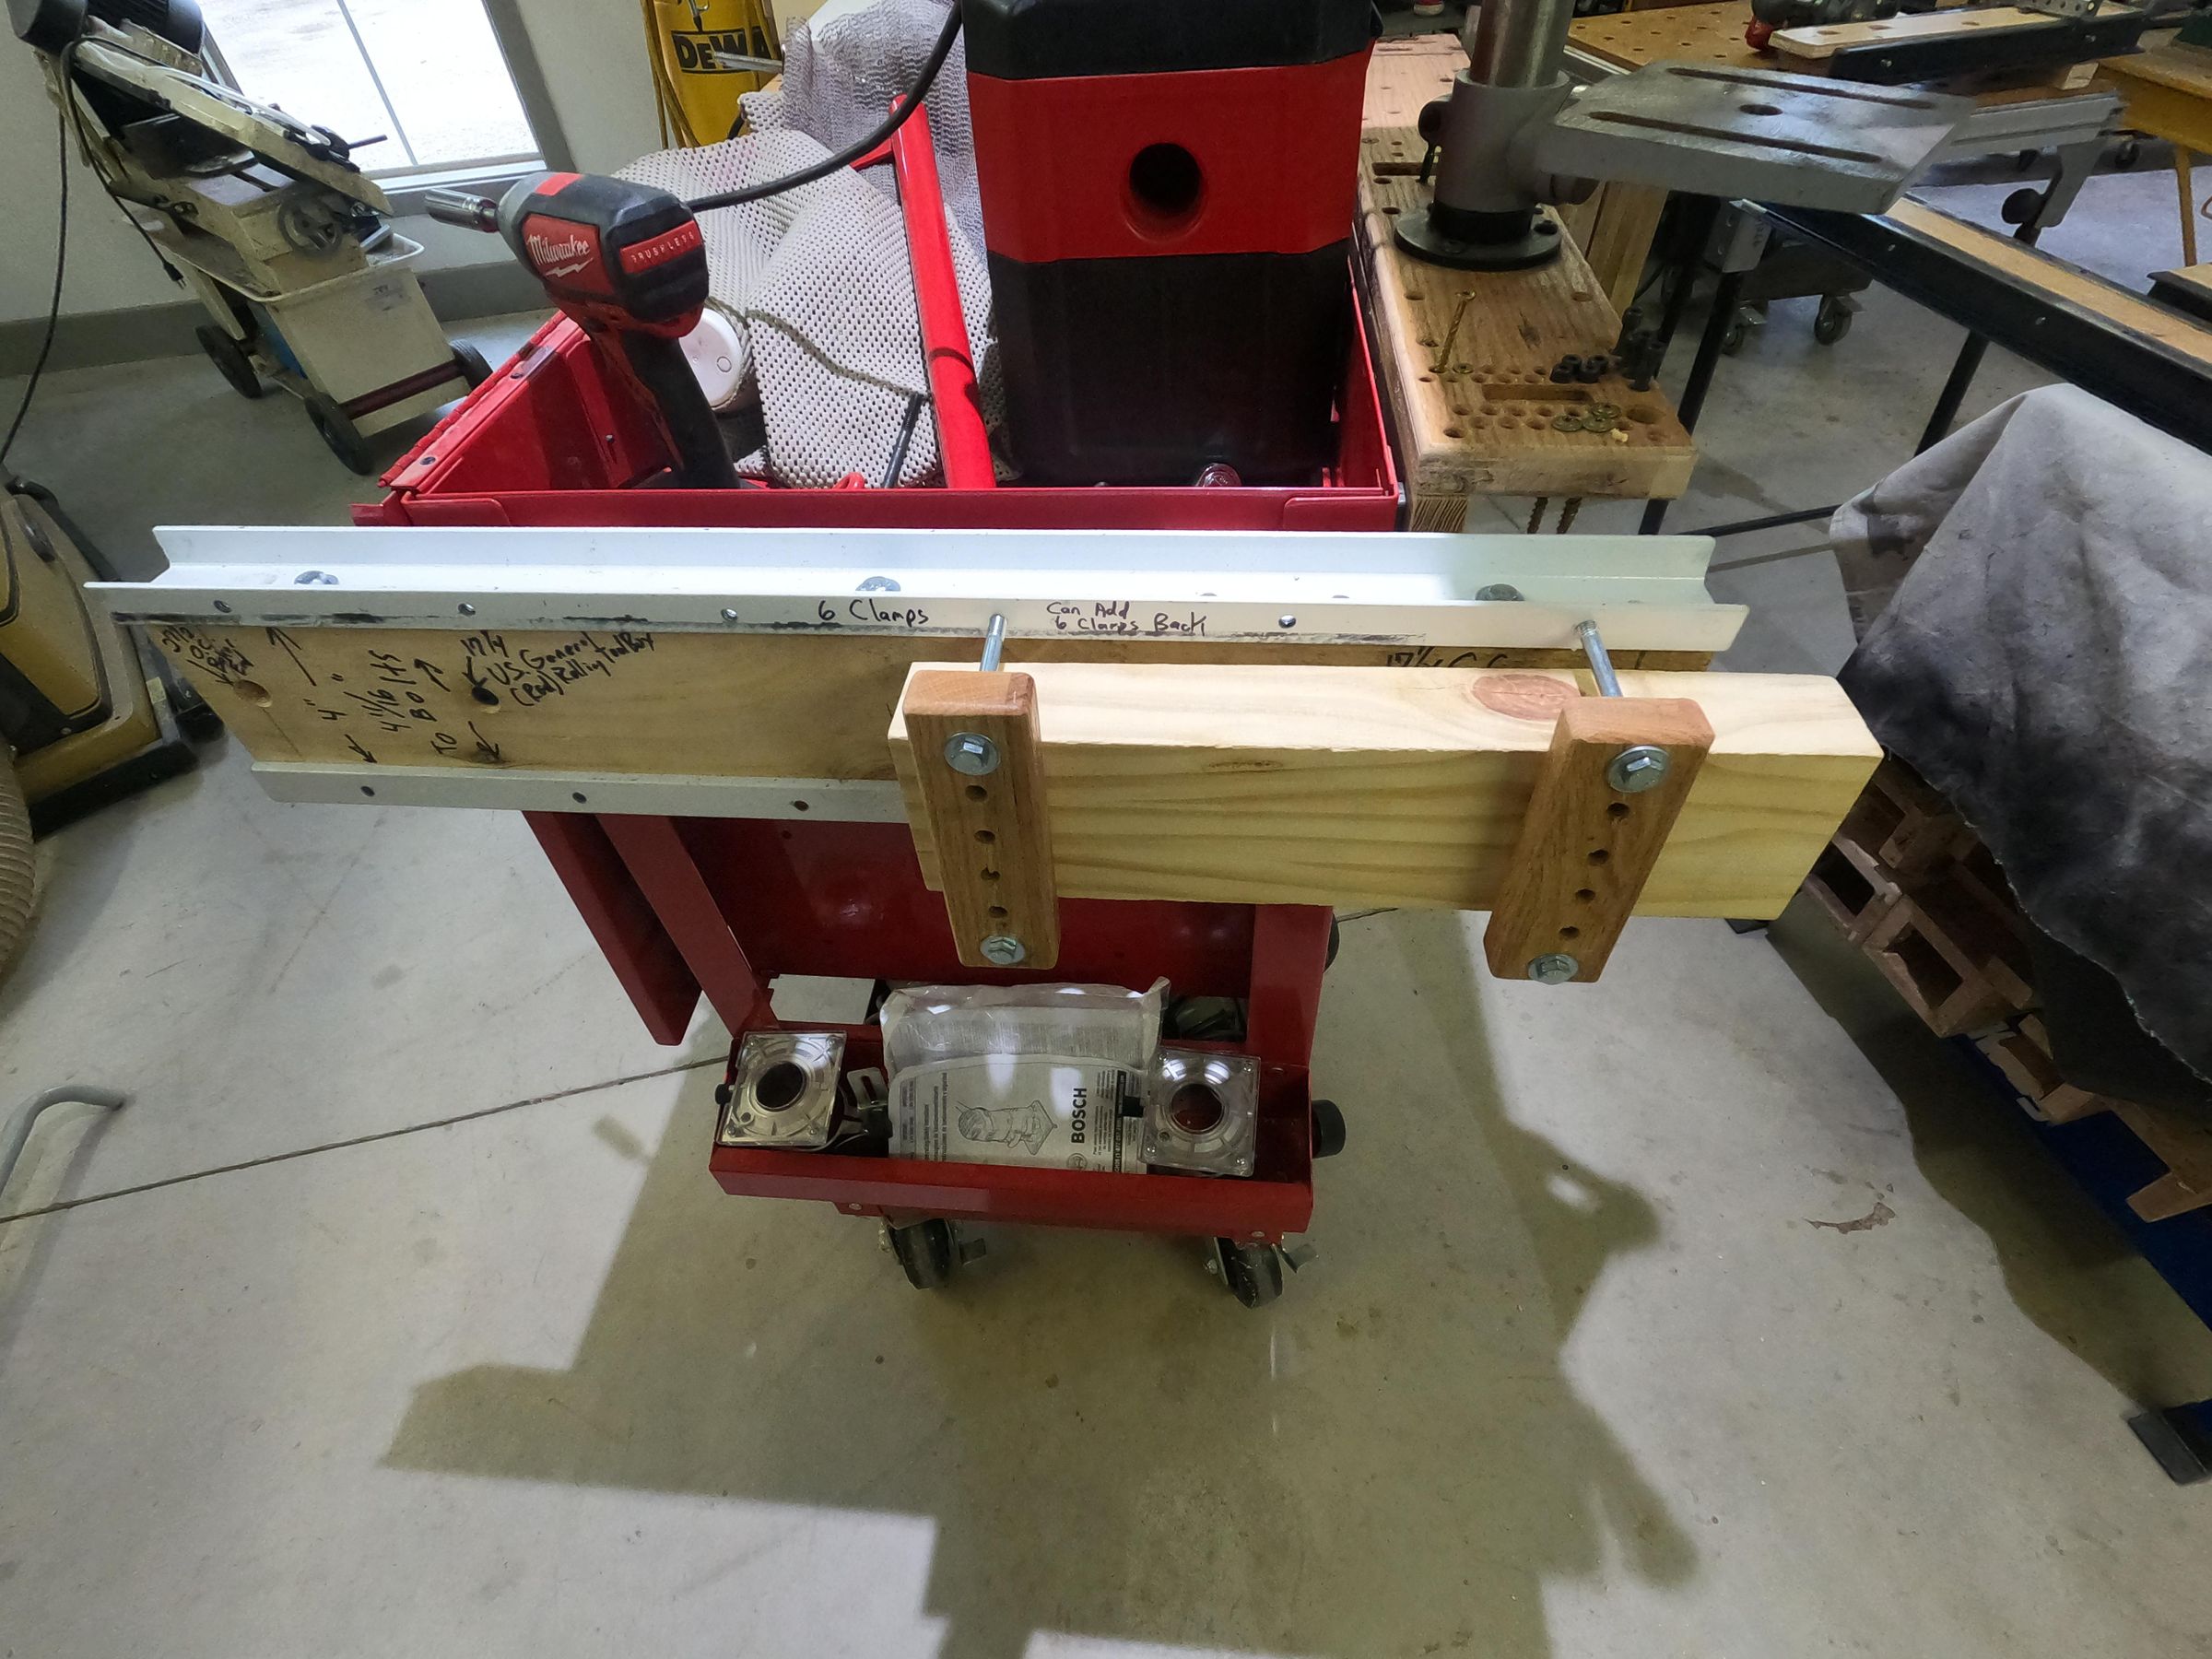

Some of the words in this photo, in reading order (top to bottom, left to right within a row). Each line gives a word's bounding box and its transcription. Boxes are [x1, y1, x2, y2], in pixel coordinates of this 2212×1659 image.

[526, 234, 591, 265] Milwaukee
[818, 600, 836, 620] 6
[849, 598, 929, 627] Clamps
[1047, 602, 1080, 615] Can
[1095, 601, 1129, 619] Add
[1055, 616, 1067, 629] 6
[1154, 612, 1206, 636] Back
[1071, 1088, 1087, 1143] BOSCH
